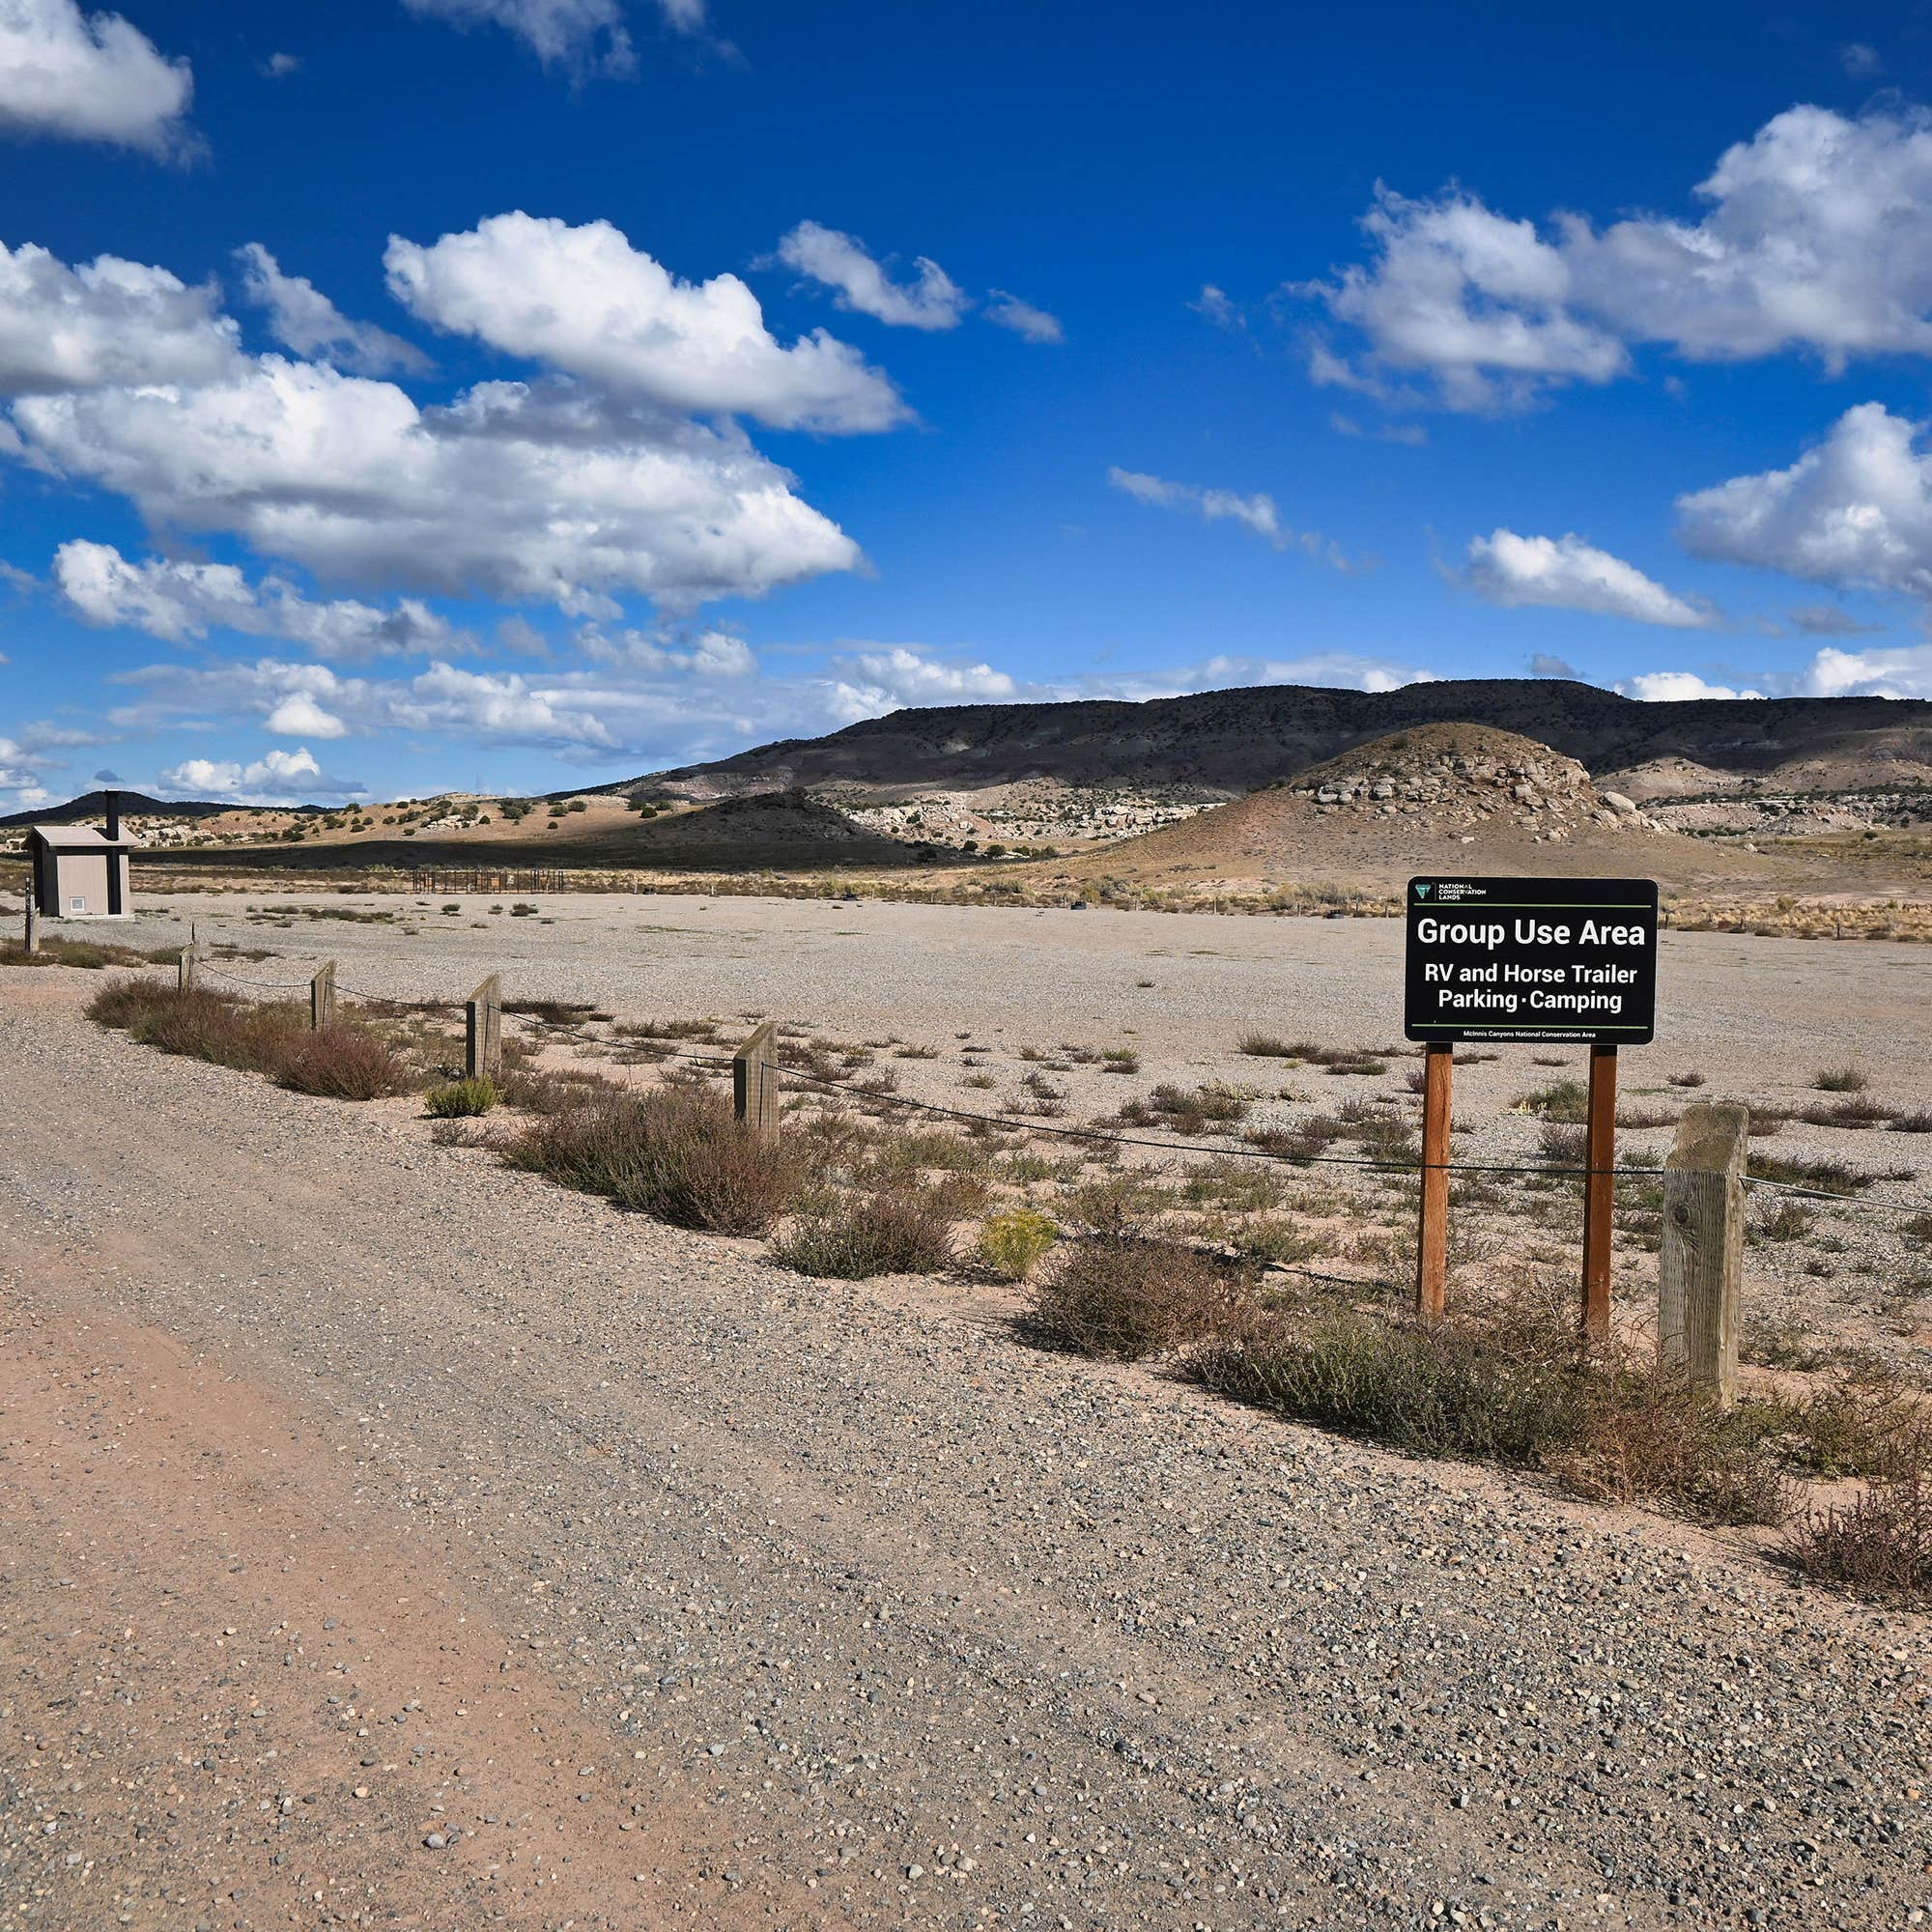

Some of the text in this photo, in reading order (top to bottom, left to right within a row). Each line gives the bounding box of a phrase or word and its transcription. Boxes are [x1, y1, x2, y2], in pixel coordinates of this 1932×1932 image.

[1418, 919, 1644, 950] Group Use Area
[1426, 963, 1637, 983] RV and Horse Trailer
[1488, 1030, 1515, 1039] Canyons
